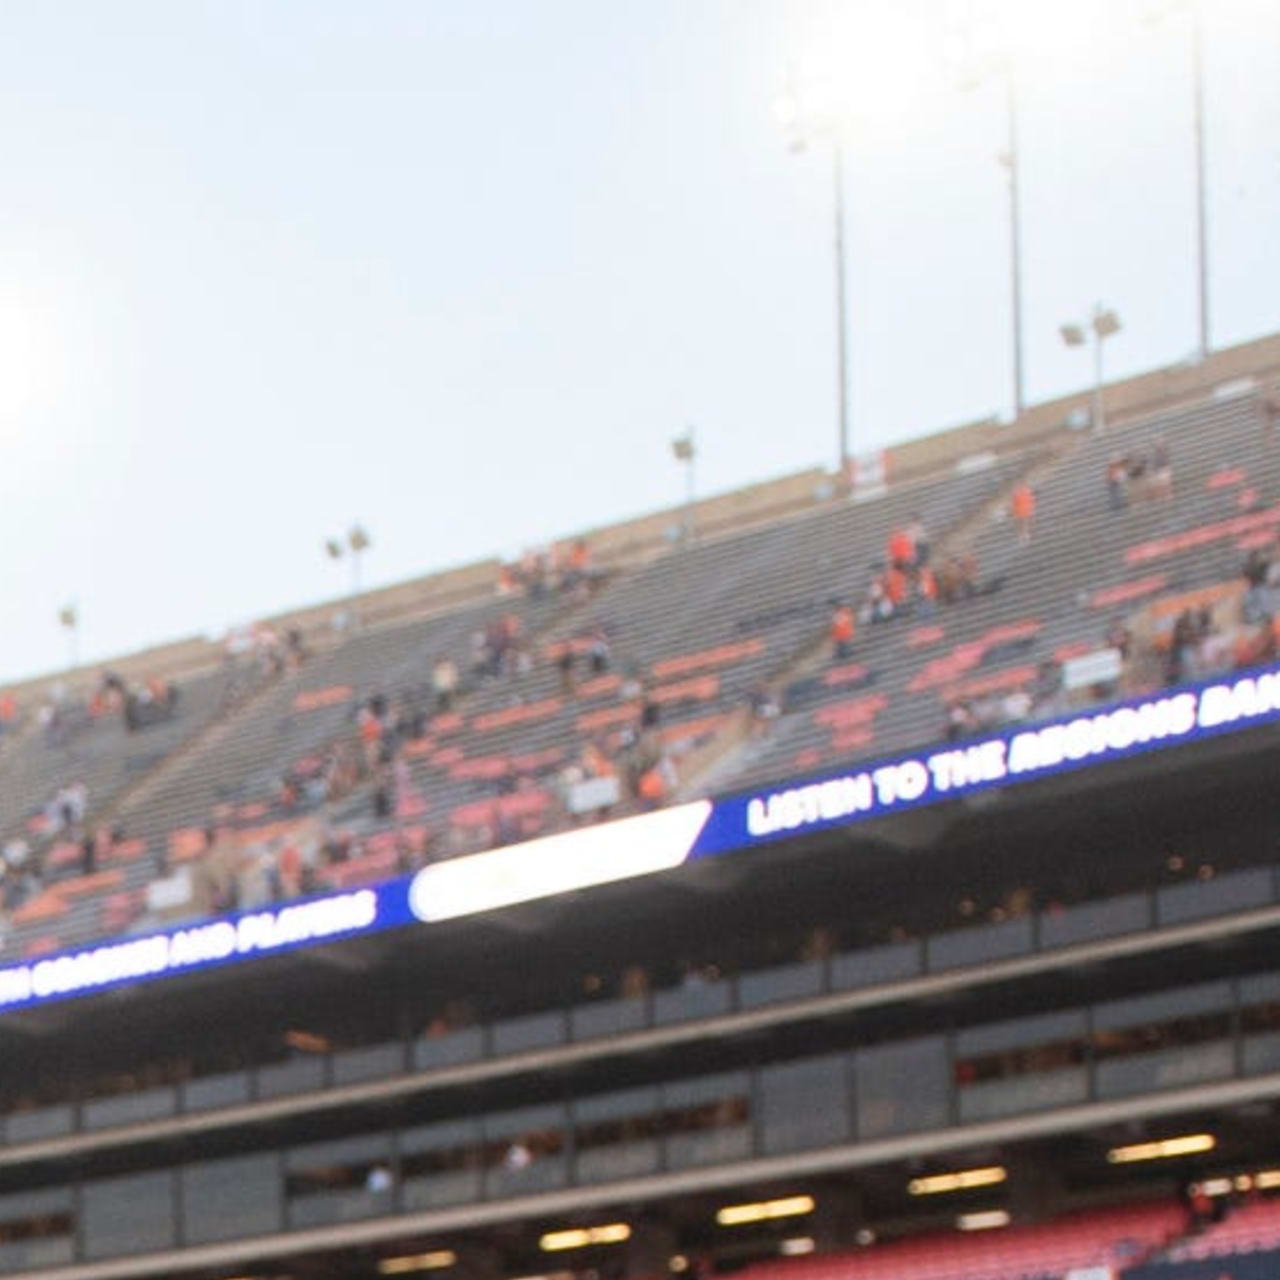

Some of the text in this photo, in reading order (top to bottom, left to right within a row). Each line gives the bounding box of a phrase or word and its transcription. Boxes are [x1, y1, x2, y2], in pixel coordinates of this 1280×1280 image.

[747, 772, 873, 835] LISTEN
[874, 761, 929, 804] TO
[930, 740, 1009, 791] THE
